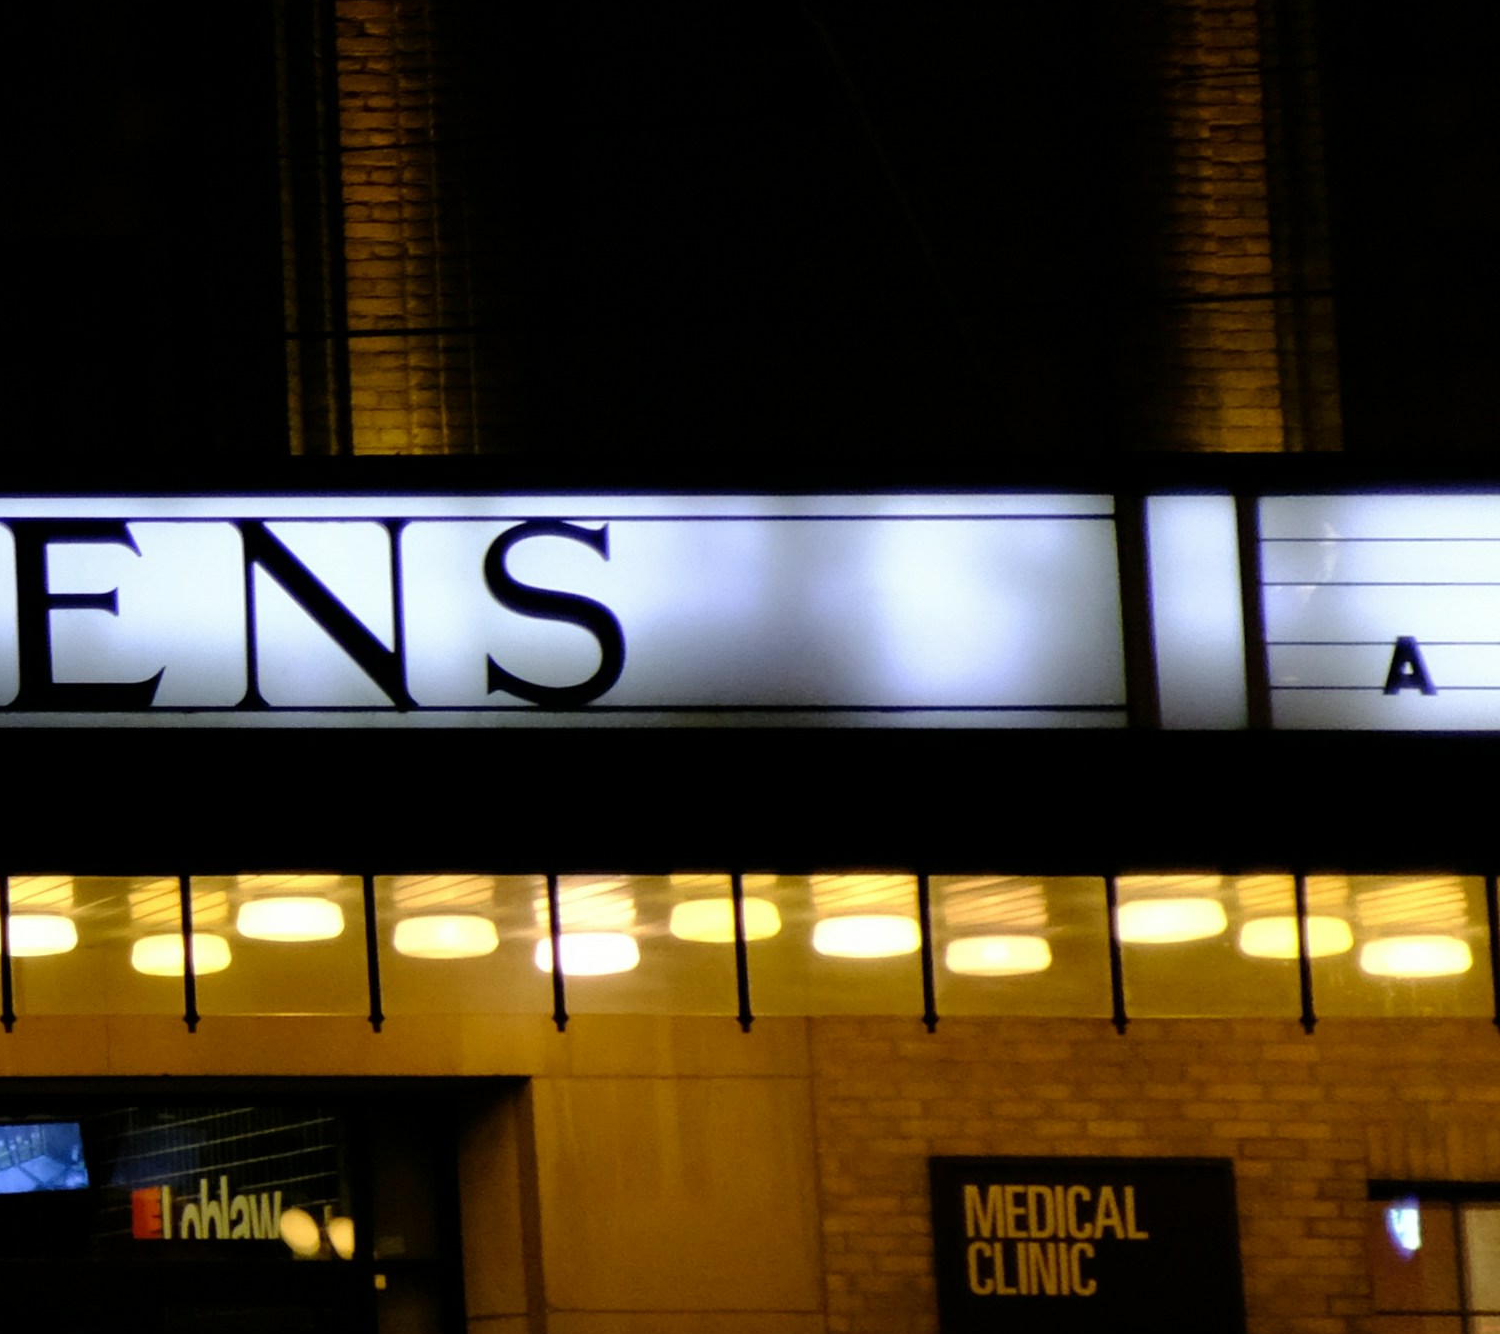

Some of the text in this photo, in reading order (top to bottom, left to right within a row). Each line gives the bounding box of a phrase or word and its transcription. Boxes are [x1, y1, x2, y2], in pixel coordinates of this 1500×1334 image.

[1384, 636, 1438, 695] A
[161, 1174, 283, 1240] Loblaw
[962, 1184, 1150, 1240] MEDICAL
[967, 1241, 1098, 1297] CLINIC
